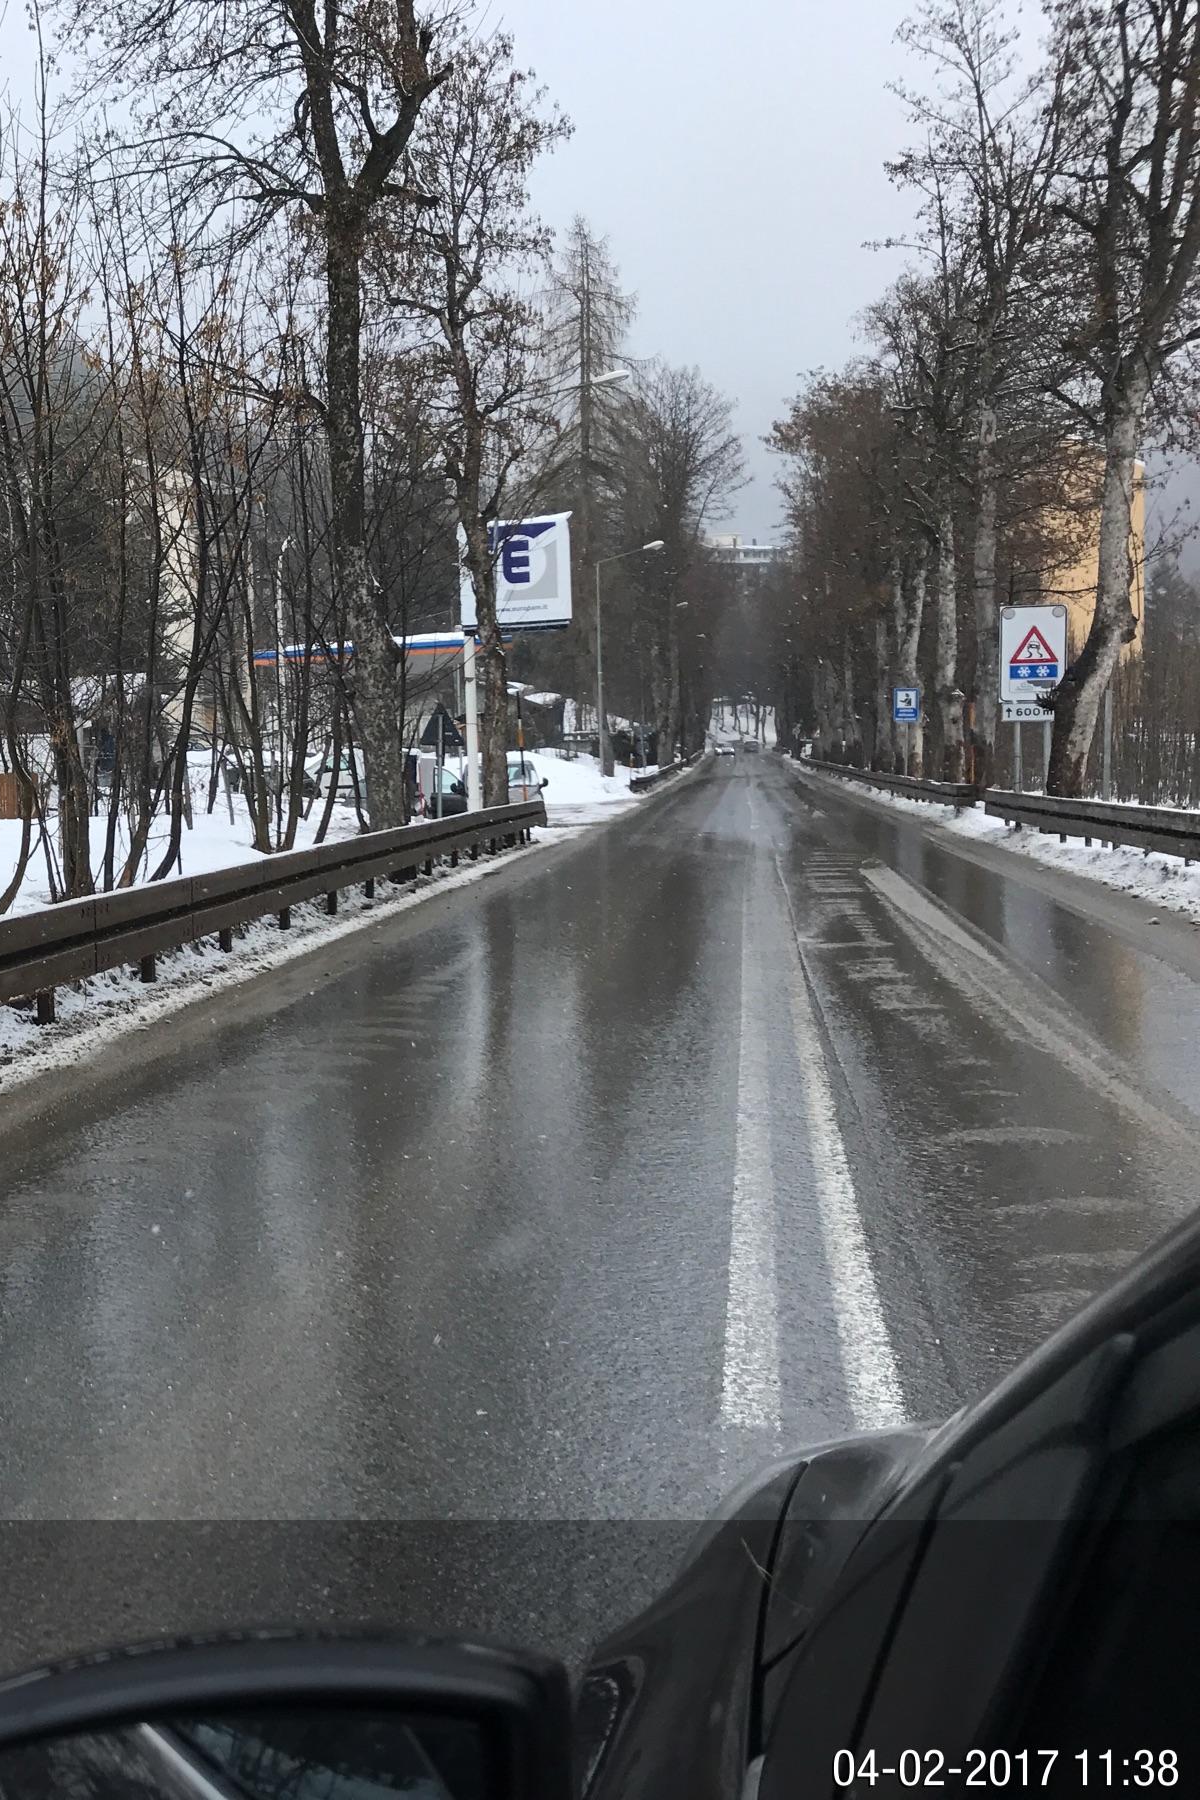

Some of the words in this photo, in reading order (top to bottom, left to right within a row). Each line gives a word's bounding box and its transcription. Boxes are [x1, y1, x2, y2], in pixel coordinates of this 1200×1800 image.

[502, 539, 530, 584] E
[1016, 707, 1041, 716] 600
[1042, 708, 1053, 716] m
